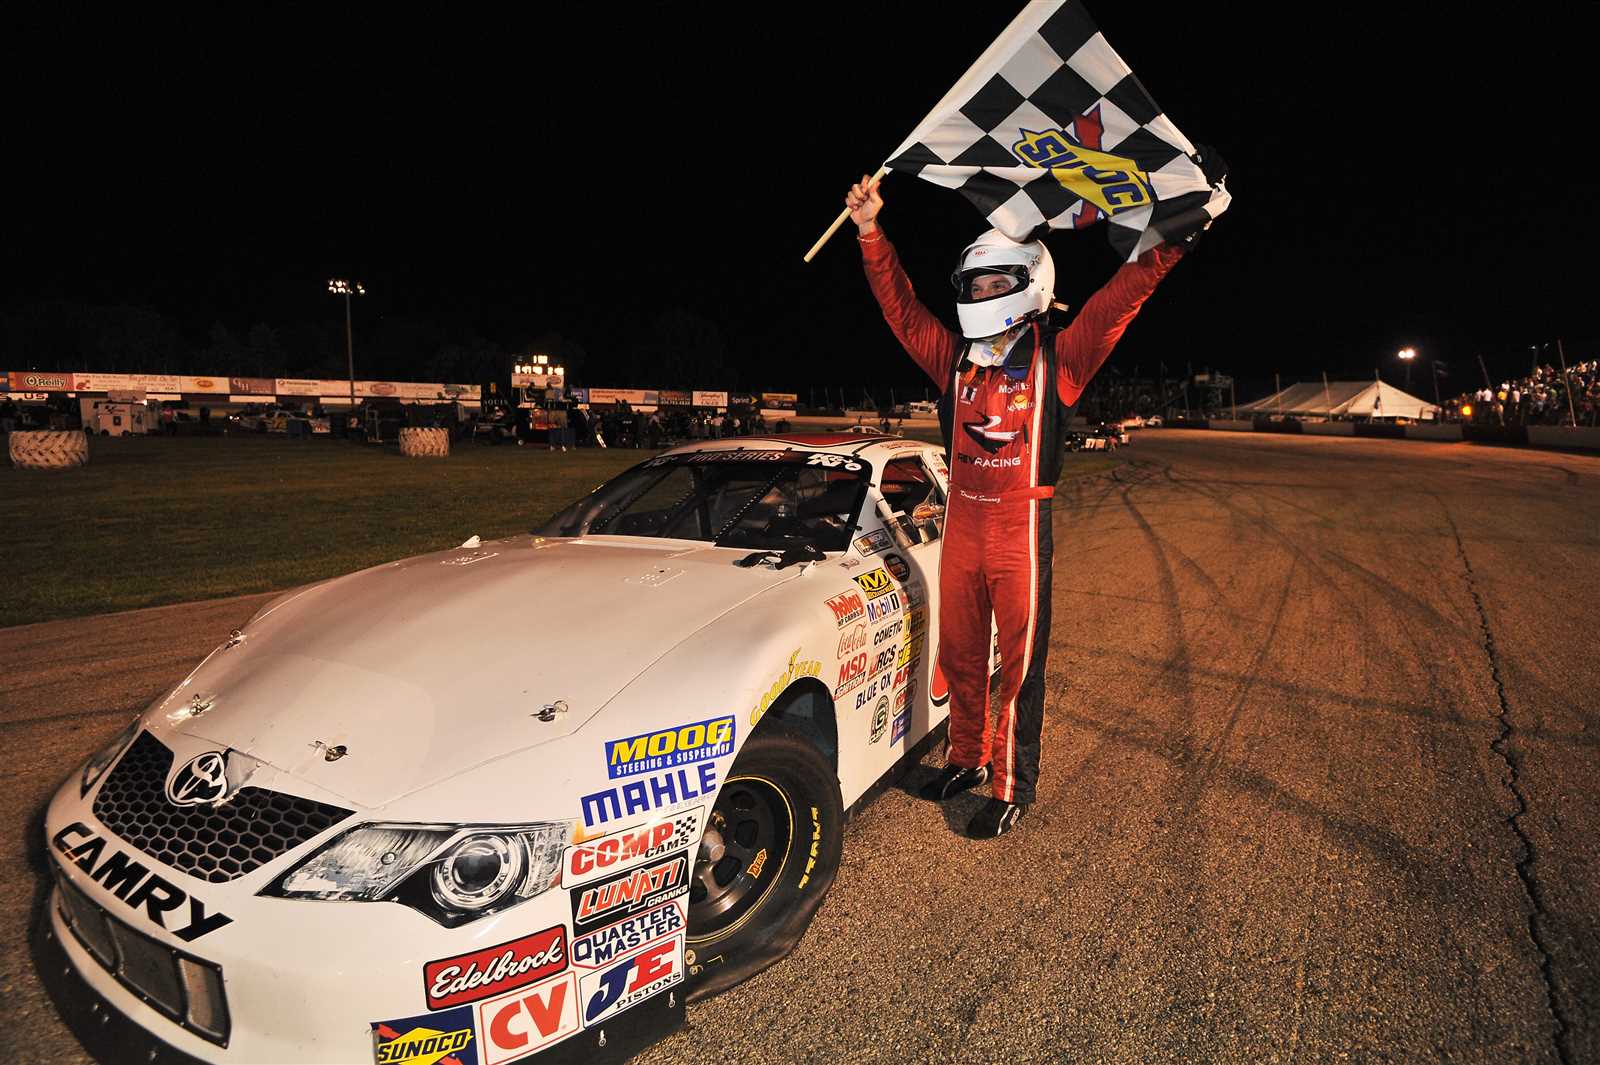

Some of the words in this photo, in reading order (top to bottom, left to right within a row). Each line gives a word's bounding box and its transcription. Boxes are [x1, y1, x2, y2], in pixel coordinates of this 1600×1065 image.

[723, 450, 785, 462] SERIES
[975, 456, 1021, 468] RACING
[866, 596, 892, 622] Mobil
[873, 619, 903, 646] COMETIC
[838, 652, 868, 688] MSD
[855, 681, 878, 710] BLUE
[880, 670, 892, 691] OX
[610, 717, 733, 767] MOOG
[616, 754, 664, 776] STEERING
[666, 752, 674, 766] &
[676, 743, 731, 765] SUSPENSION
[580, 761, 717, 829] MAHLE
[570, 821, 675, 876] COMP
[644, 835, 690, 860] CAMS
[51, 821, 235, 943] CAMRY
[579, 859, 681, 920] LUNATI
[647, 884, 690, 909] CRANKS
[573, 904, 677, 962] QUARTER
[594, 916, 683, 965] MASTER
[429, 936, 564, 999] Edelbrock
[585, 940, 676, 1022] JE
[616, 972, 683, 1010] PISTONS
[489, 980, 570, 1051] CV
[377, 1027, 470, 1062] SUNOCO
